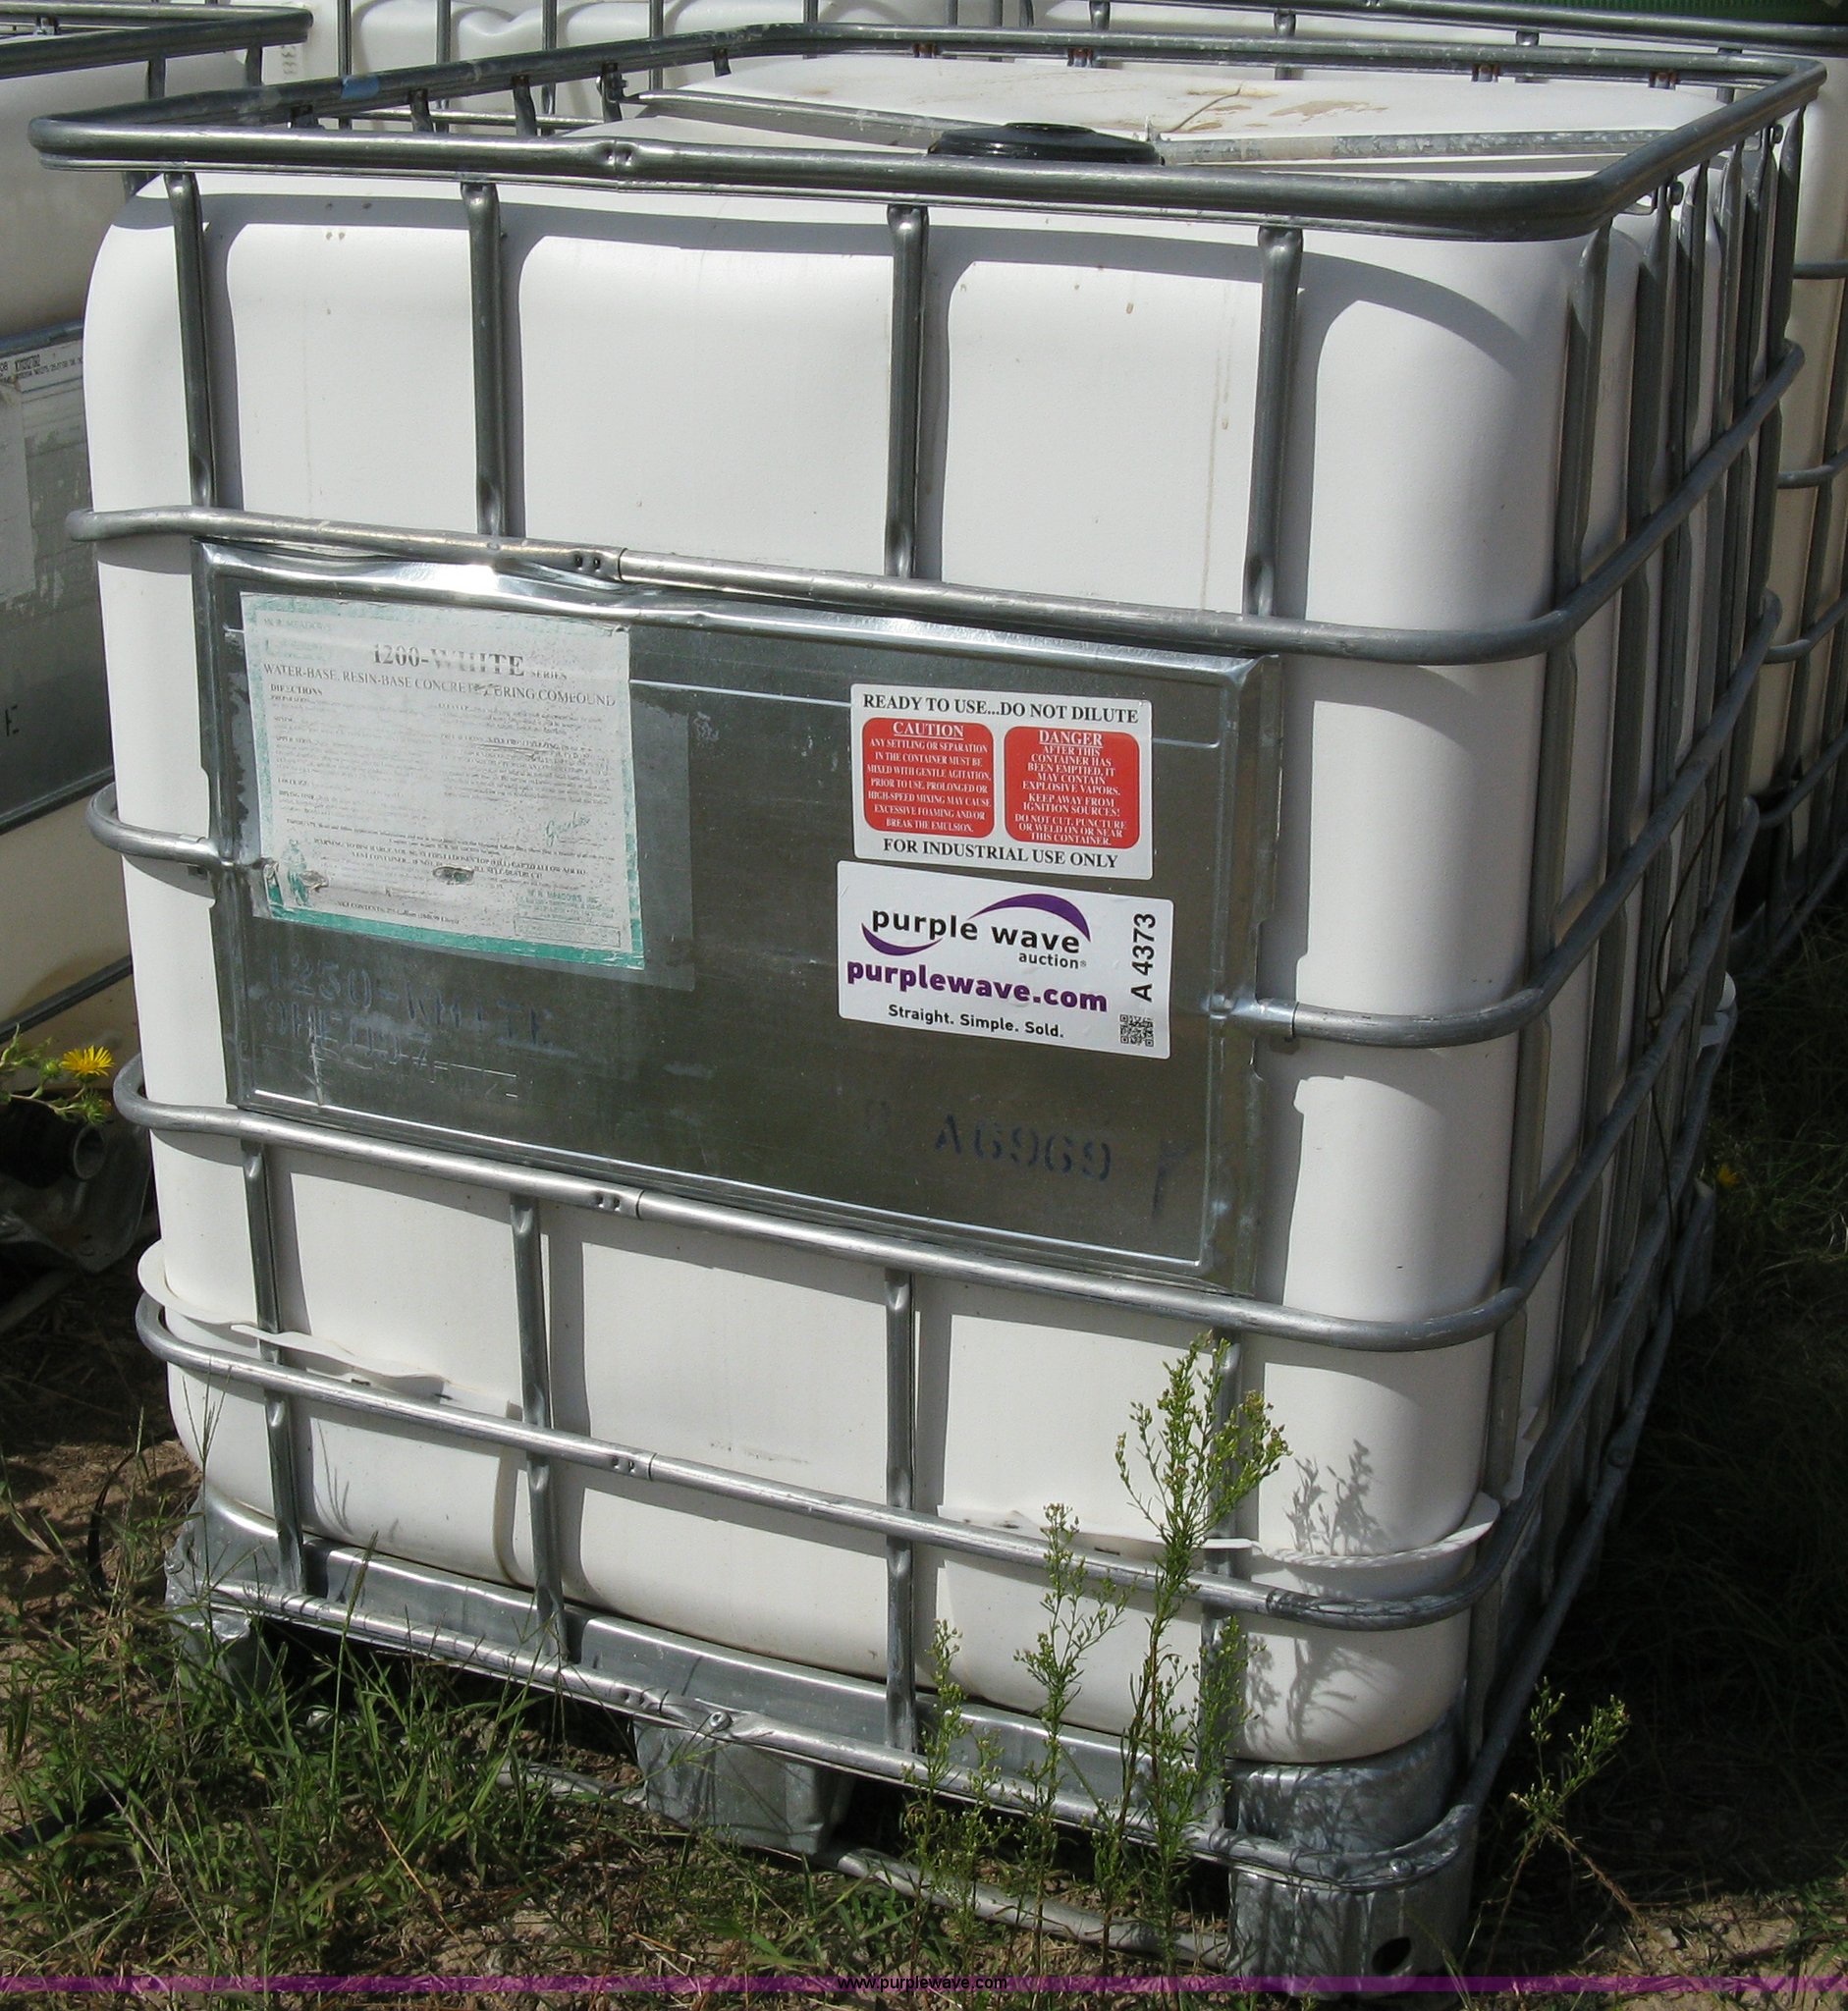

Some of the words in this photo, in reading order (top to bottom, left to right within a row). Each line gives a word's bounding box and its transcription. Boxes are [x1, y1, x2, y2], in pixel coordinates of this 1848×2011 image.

[344, 671, 410, 687] RESIN-BASE
[863, 693, 922, 711] READY
[926, 697, 950, 712] TO
[1030, 703, 1067, 719] NOT
[1072, 706, 1139, 724] DILUTE
[893, 721, 964, 737] CAUTION
[870, 738, 885, 747] ANY
[887, 739, 925, 749] SETTLING
[927, 741, 938, 751] OR
[940, 742, 988, 753] SEPARATION
[1039, 730, 1103, 746] DANGER
[875, 751, 883, 760] IN
[886, 752, 901, 762] THE
[903, 753, 948, 765] CONTAINER
[949, 756, 971, 766] MUST
[972, 757, 983, 767] BE
[1044, 745, 1075, 755] AFTER
[1078, 747, 1100, 757] THIS
[1031, 754, 1090, 766] CONTAINER
[1092, 757, 1112, 767] HAS
[867, 764, 893, 774] MIXED
[894, 765, 914, 775] WITH
[915, 766, 946, 778] GENTLE
[1028, 762, 1053, 773] BEEN
[1105, 767, 1115, 777] IT
[871, 778, 895, 788] PRIOR
[897, 779, 908, 788] TO
[926, 782, 975, 793] PROLONGED
[976, 785, 988, 794] OR
[1022, 781, 1078, 792] EXPLOSIVE
[1038, 772, 1059, 782] MAY
[1060, 774, 1106, 785] CONTAIN
[868, 790, 915, 802] HIGH-SPEED
[917, 793, 945, 804] MIXING
[947, 796, 964, 805] MAY
[965, 797, 991, 807] CAUSE
[1028, 793, 1055, 803] KEEP
[1058, 794, 1083, 805] AWAY
[1085, 797, 1114, 807] FROM
[874, 804, 916, 815] EXCESSIVE
[918, 806, 953, 818] FOAMING
[955, 809, 985, 821] AND/OR
[1023, 801, 1069, 813] IGNITION
[1071, 805, 1120, 817] SOURCES!
[886, 818, 913, 829] BREAK
[914, 819, 930, 830] THE
[1014, 814, 1029, 823] DO
[1030, 814, 1050, 824] NOT
[1075, 818, 1126, 830] PUNCTURE
[1018, 822, 1032, 832] OR
[1034, 823, 1062, 834] WELD
[1064, 826, 1078, 835] ON
[1080, 827, 1094, 836] OR
[1097, 828, 1122, 838] NEAR
[1030, 832, 1052, 842] THIS
[884, 838, 918, 854] FOR
[923, 841, 1028, 862] INDUSTRIAL
[1032, 849, 1066, 864] USE
[1069, 852, 1118, 868] ONLY
[872, 909, 978, 941] purple
[991, 925, 1081, 954] wave
[1131, 912, 1157, 977] 4373
[846, 959, 1109, 1013] purplewave.com
[1130, 983, 1154, 1003] A
[888, 1004, 954, 1026] Straight.
[960, 1013, 1020, 1034] Simple.
[1024, 1021, 1064, 1039] Sold.
